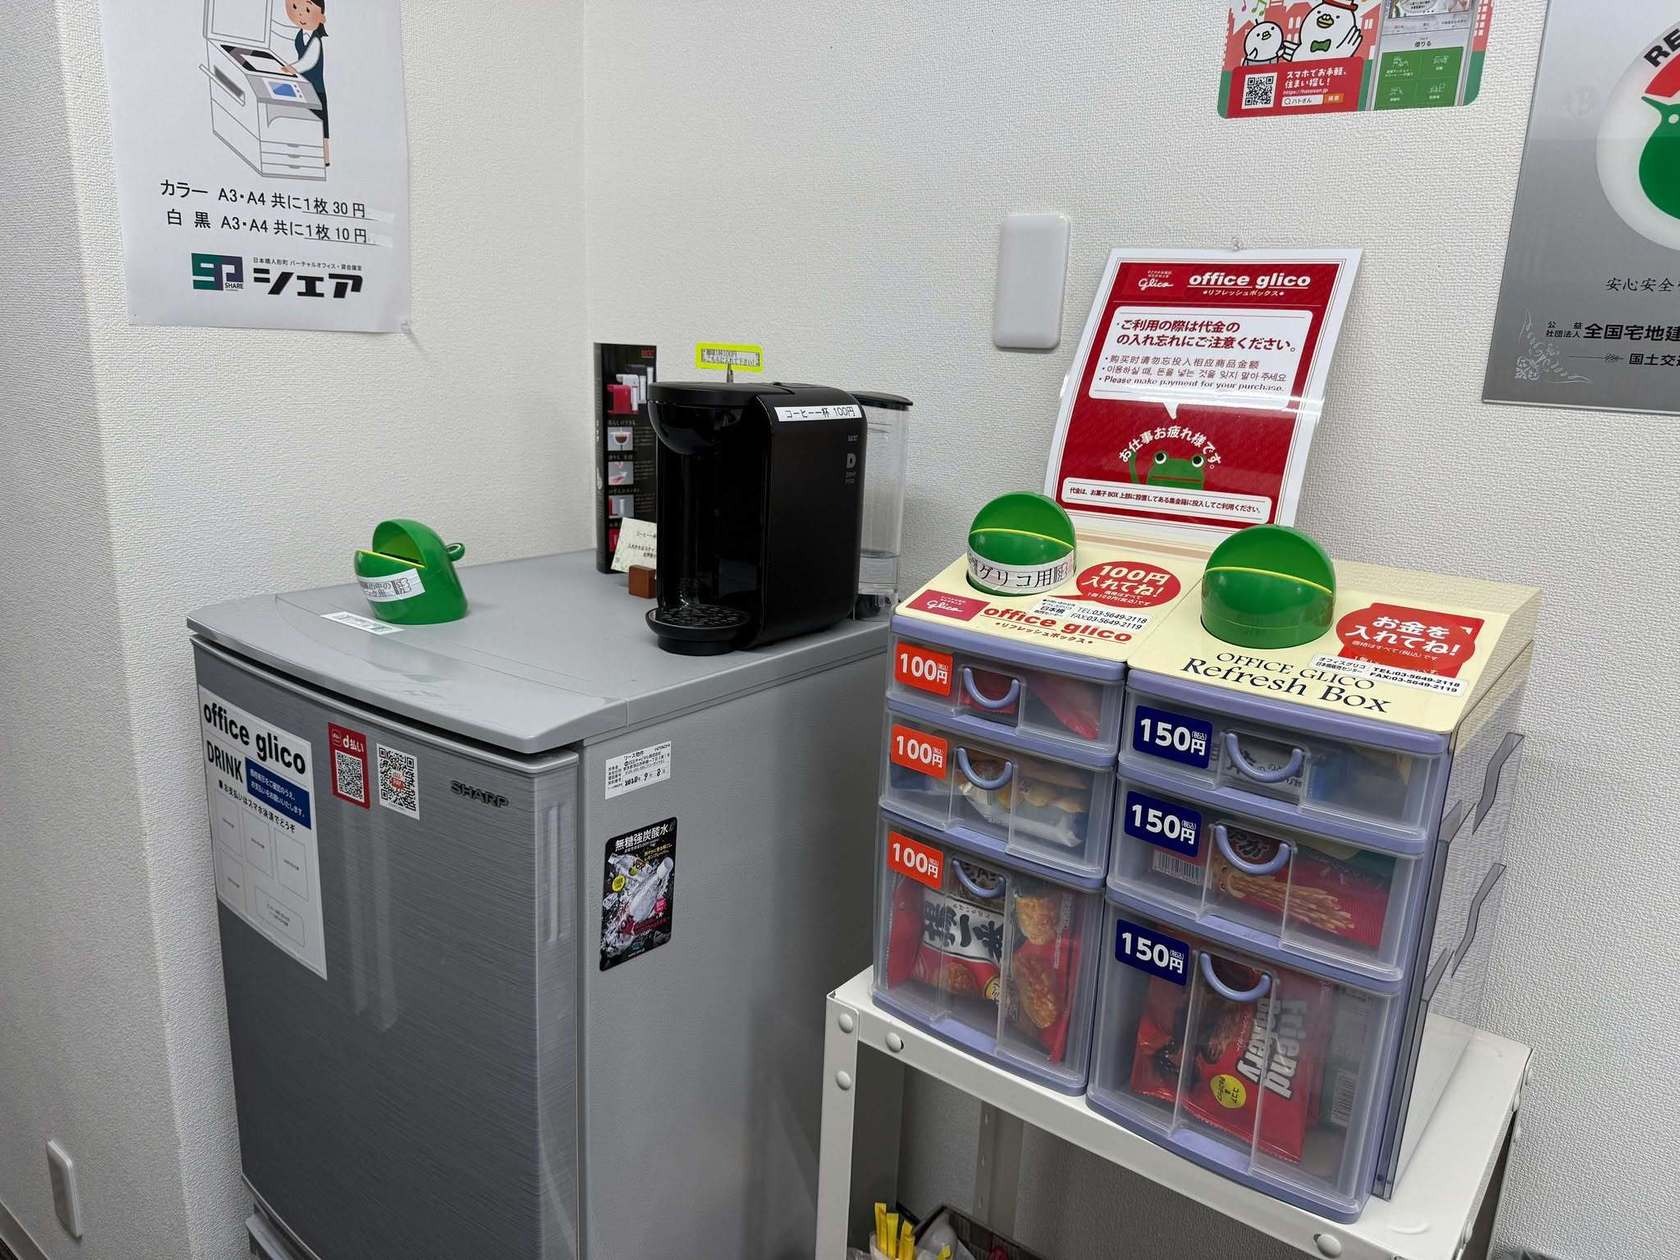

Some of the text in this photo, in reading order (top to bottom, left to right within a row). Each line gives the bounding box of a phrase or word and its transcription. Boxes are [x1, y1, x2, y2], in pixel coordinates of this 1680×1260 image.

[160, 179, 209, 198] カラー
[332, 201, 349, 215] 30
[352, 202, 367, 218] 円
[335, 227, 350, 240] 10
[354, 228, 367, 243] 円
[253, 267, 363, 299] シェア
[1138, 278, 1174, 291] Glico
[1188, 272, 1250, 287] office
[1255, 273, 1312, 289] glico
[1606, 277, 1680, 292] 安心安全
[1116, 334, 1296, 353] の入れ忘れにご注意ください。
[1629, 353, 1680, 367] 国土交
[1104, 375, 1132, 384] Please
[1159, 380, 1199, 388] payment
[1215, 382, 1238, 390] your
[833, 406, 856, 417] 100円
[1119, 425, 1222, 470] お仕事お疲れ様です。
[1099, 565, 1172, 585] 100円
[984, 607, 1132, 642] office glico
[1372, 615, 1450, 639] お金を
[1345, 625, 1461, 657] 入れてね!
[900, 653, 948, 685] 100円
[1180, 657, 1308, 697] Refresh
[1216, 652, 1375, 690] OFFICE GLICO
[1372, 666, 1461, 688] TEL:03-5649-2118
[203, 702, 306, 775] office glico
[896, 735, 943, 769] 100円
[1140, 718, 1206, 756] 150円
[206, 739, 244, 784] DRINK
[450, 779, 510, 808] SHARP
[1132, 804, 1195, 845] 150円
[893, 843, 939, 879] 100円
[1122, 932, 1184, 974] 150円
